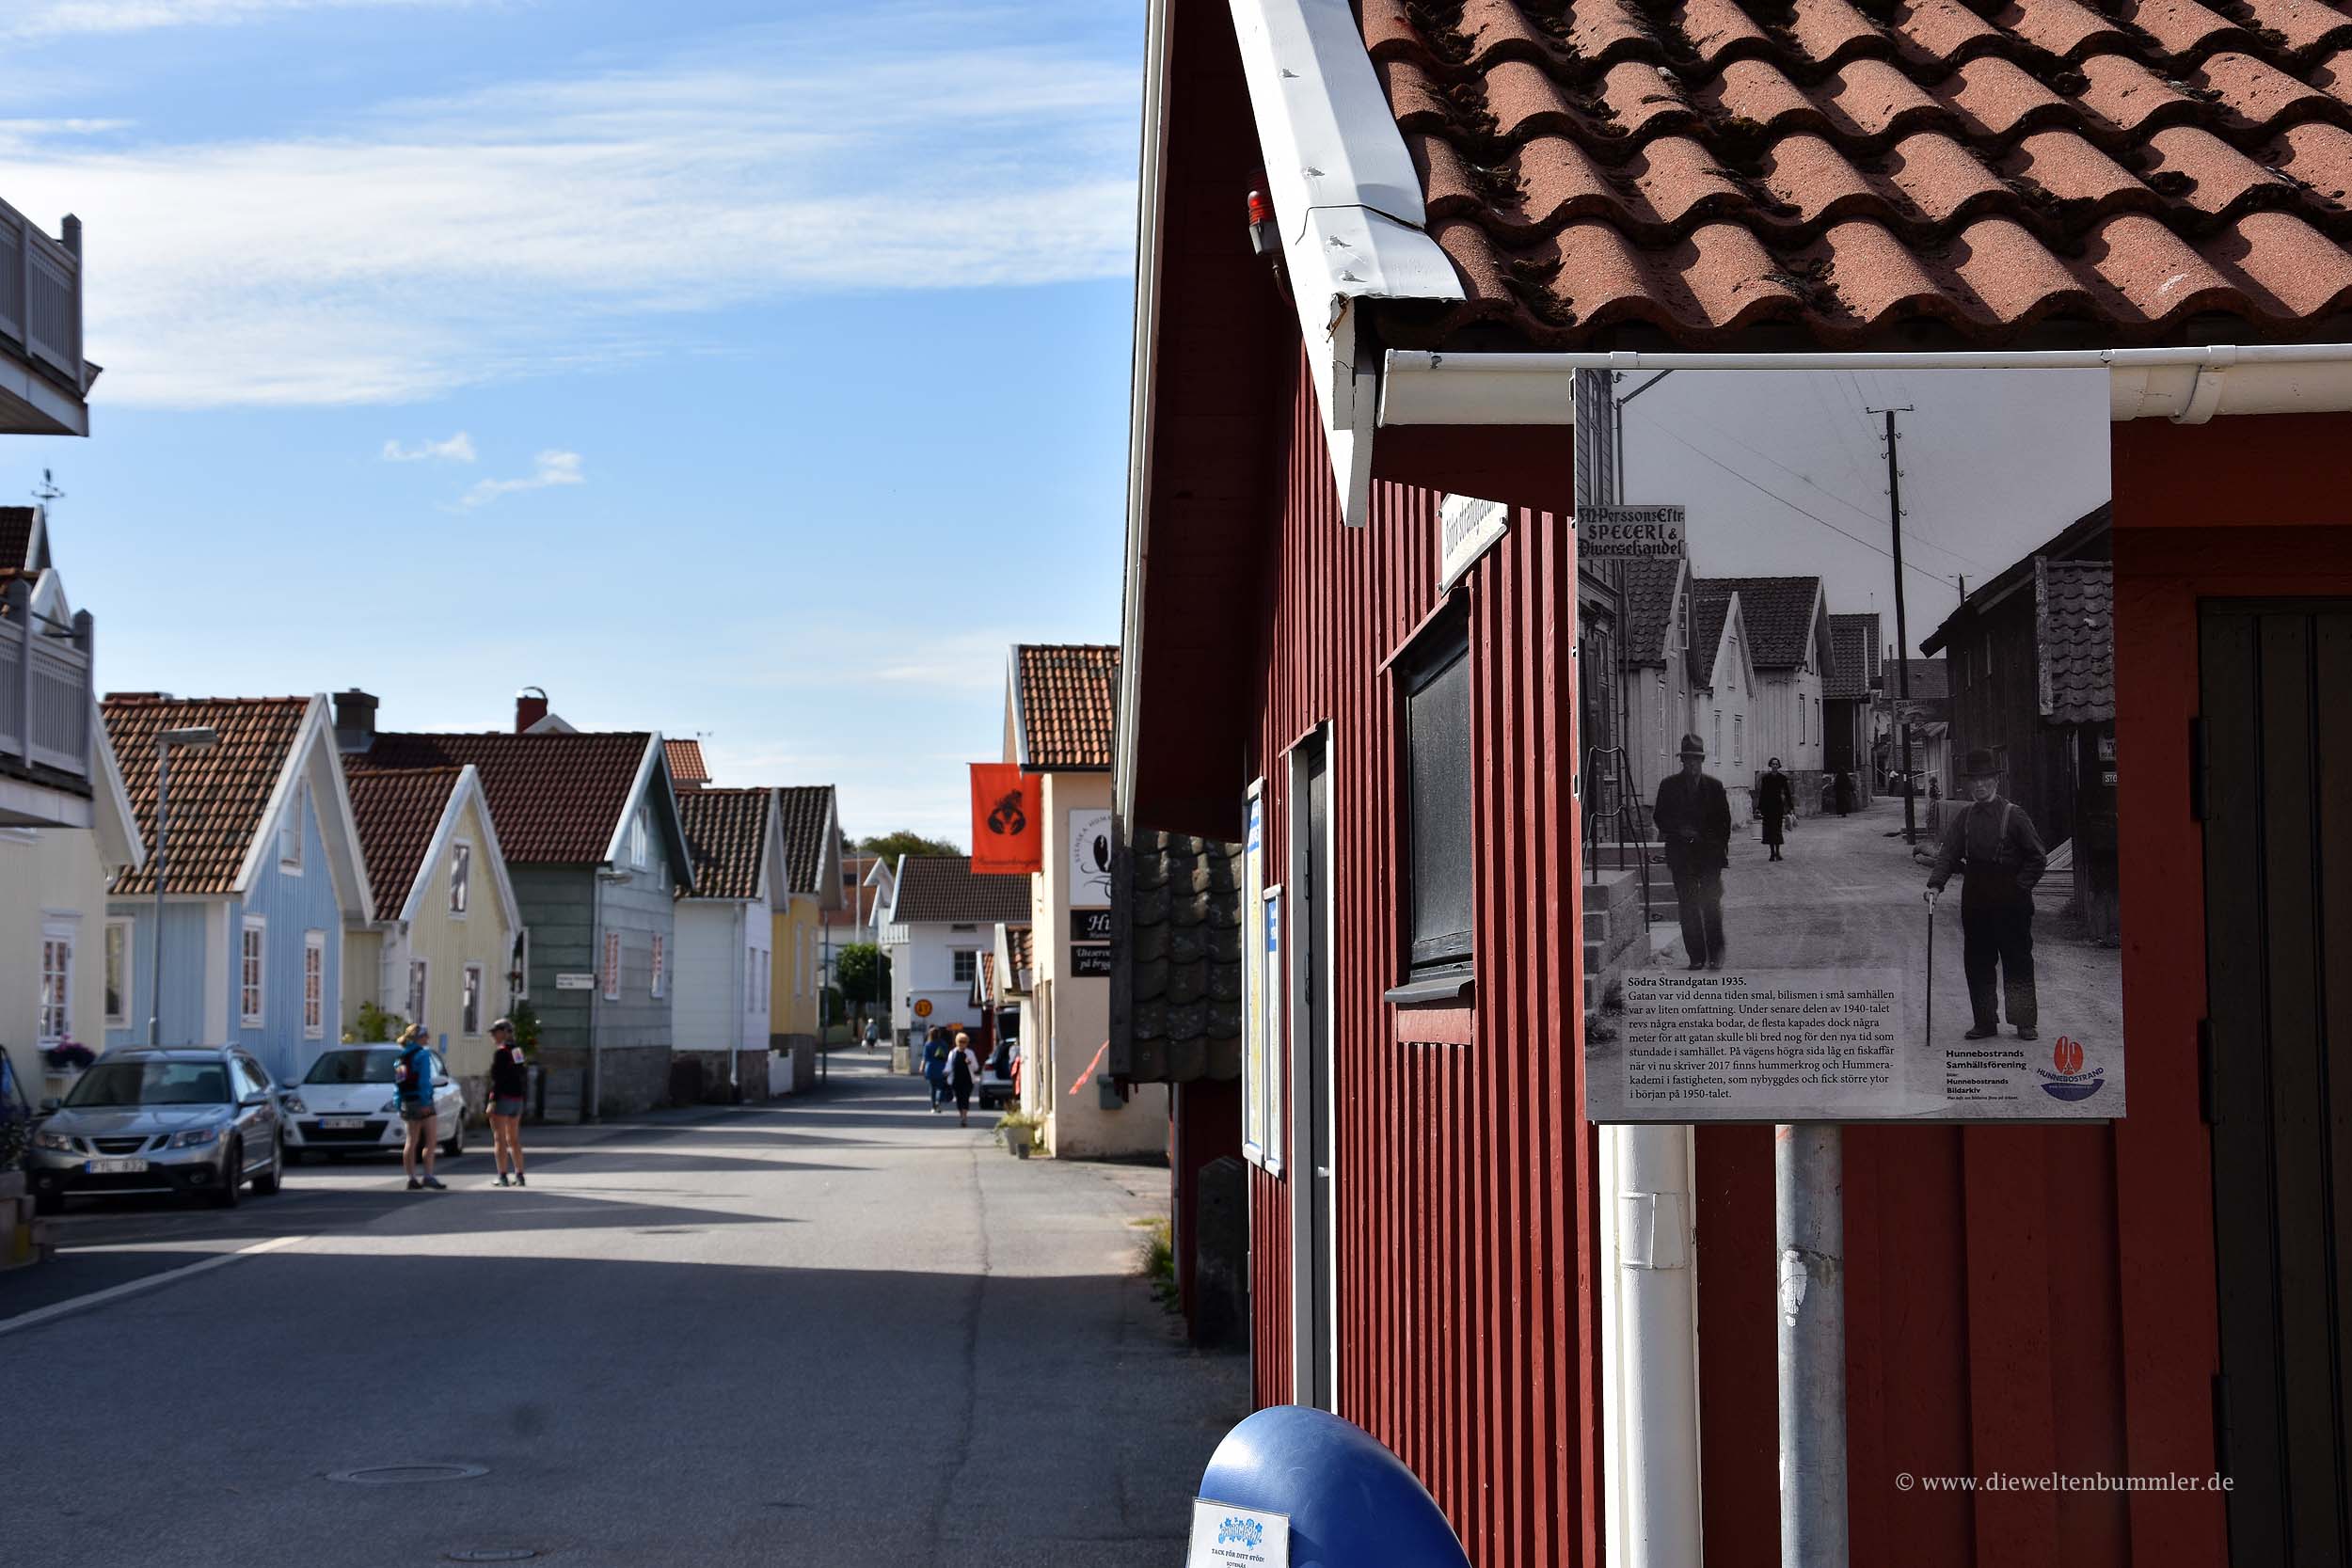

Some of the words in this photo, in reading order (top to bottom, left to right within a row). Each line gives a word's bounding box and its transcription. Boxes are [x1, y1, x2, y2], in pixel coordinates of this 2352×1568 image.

[1668, 528, 1678, 540] &
[1628, 976, 1656, 986] Södra
[1659, 976, 1718, 988] Strandgatan
[1722, 975, 1747, 986] 1935.
[1629, 990, 1656, 1000] Gatan
[1676, 990, 1691, 1000] vid
[1692, 990, 1722, 1000] denna
[1724, 990, 1749, 1000] tiden
[1751, 990, 1776, 1002] smal,
[1777, 990, 1818, 999] bilismen
[1825, 990, 1845, 999] små
[1847, 989, 1895, 999] samhällen
[1658, 1005, 1679, 1014] liten
[1681, 1005, 1736, 1016] omfattning.
[1739, 1004, 1768, 1013] Under
[1803, 1004, 1828, 1013] delen
[1843, 1003, 1890, 1013] 1940-talet
[1650, 1019, 1677, 1031] några
[1678, 1019, 1713, 1028] enstaka
[1716, 1018, 1745, 1030] bodar,
[1748, 1018, 1760, 1027] de
[1761, 1018, 1786, 1027] flesta
[1788, 1018, 1825, 1030] kapades
[1828, 1018, 1851, 1027] dock
[1852, 1017, 1880, 1029] några
[1629, 1034, 1656, 1042] meter
[1659, 1033, 1672, 1042] för
[1674, 1034, 1687, 1042] att
[1689, 1034, 1714, 1044] gatan
[1716, 1032, 1744, 1042] skulle
[1746, 1032, 1758, 1041] bli
[1760, 1032, 1782, 1041] bred
[1784, 1034, 1803, 1044] nog
[1804, 1032, 1818, 1041] för
[1820, 1032, 1837, 1041] den
[1839, 1034, 1856, 1043] nya
[1859, 1031, 1872, 1041] tid
[1629, 1047, 1672, 1056] stundade
[1679, 1047, 1726, 1056] samhället.
[1729, 1046, 1741, 1056] På
[1743, 1046, 1774, 1058] vägens
[1777, 1046, 1804, 1058] högra
[1806, 1046, 1825, 1055] sida
[1827, 1046, 1841, 1057] låg
[1857, 1045, 1895, 1055] fiskaffär
[1946, 1050, 2025, 1058] Hunnebostrands
[1629, 1061, 1645, 1070] när
[1647, 1061, 1657, 1070] vi
[1673, 1061, 1706, 1070] skriver
[1708, 1060, 1730, 1070] 2017
[1732, 1060, 1756, 1070] finns
[1758, 1060, 1820, 1072] hummerkrog
[1822, 1060, 1839, 1069] och
[1842, 1059, 1894, 1069] Hummera-
[1946, 1060, 2027, 1070] Samhällsförening
[1629, 1075, 1664, 1085] kademi
[1672, 1075, 1725, 1086] fastigheten,
[1750, 1074, 1799, 1086] nybyggdes
[1802, 1074, 1819, 1084] och
[1821, 1074, 1838, 1084] fick
[1840, 1073, 1867, 1084] större
[1869, 1075, 1889, 1085] ytor
[2036, 1067, 2105, 1083] HUNNEBOSTRAND
[1635, 1089, 1666, 1101] början
[1669, 1089, 1680, 1101] på
[1683, 1089, 1732, 1099] 1950-talet.
[1226, 1549, 1235, 1559] FÖR
[1236, 1552, 1248, 1560] DITT
[1249, 1554, 1265, 1562] STÖD!
